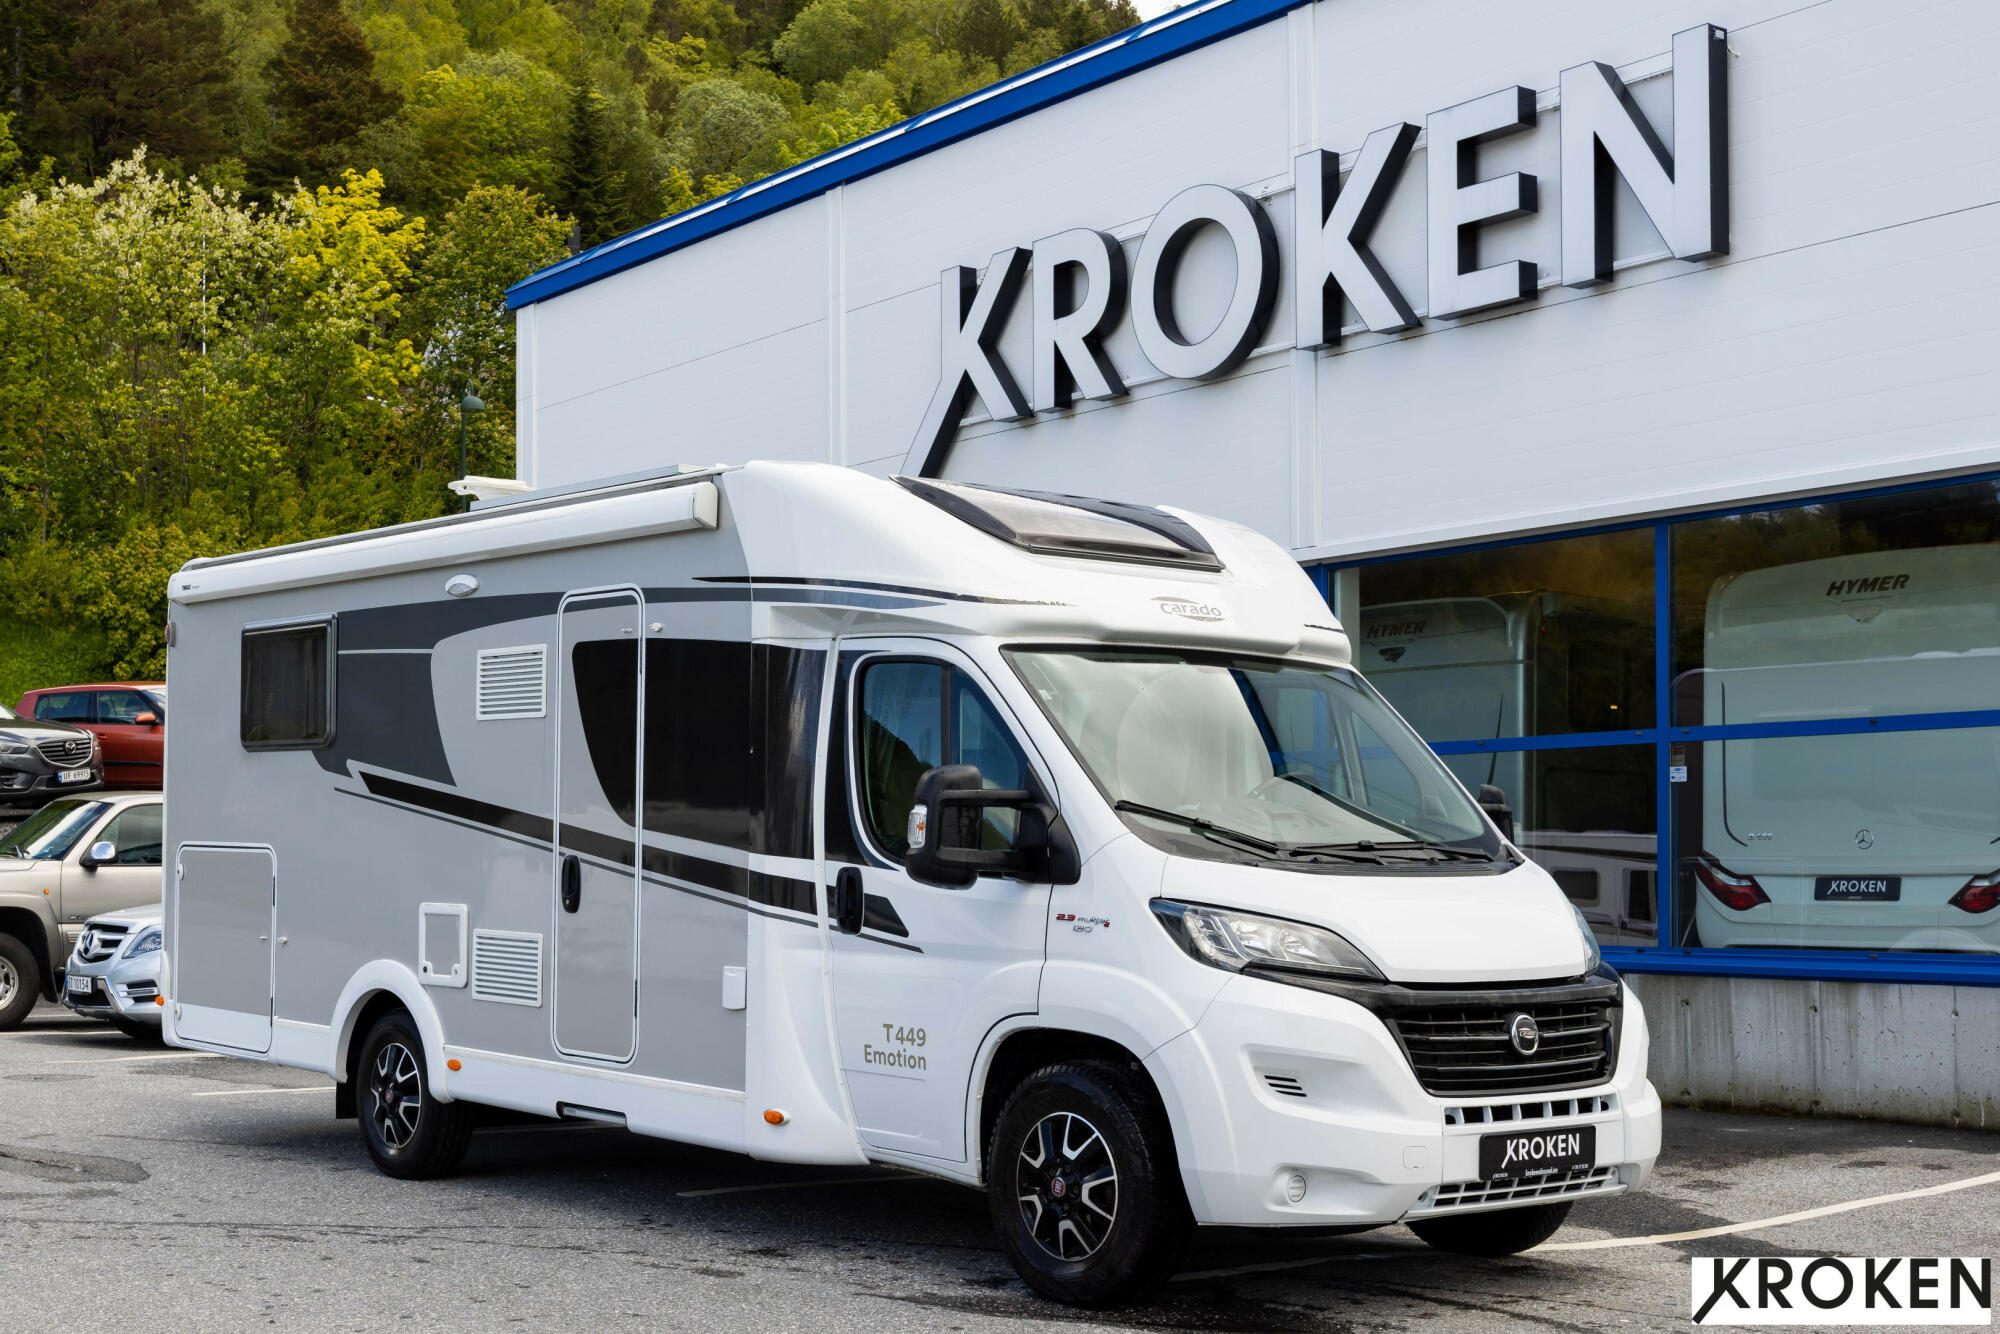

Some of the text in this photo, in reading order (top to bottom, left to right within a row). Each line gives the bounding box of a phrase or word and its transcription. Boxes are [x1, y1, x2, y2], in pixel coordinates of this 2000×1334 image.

[900, 23, 1729, 477] KROKEN
[1826, 574, 1909, 596] HYMER
[1366, 620, 1427, 638] HYMER
[1827, 880, 1887, 895] KROKEN
[864, 1044, 927, 1071] Emotion
[1501, 1133, 1580, 1169] KROKEN
